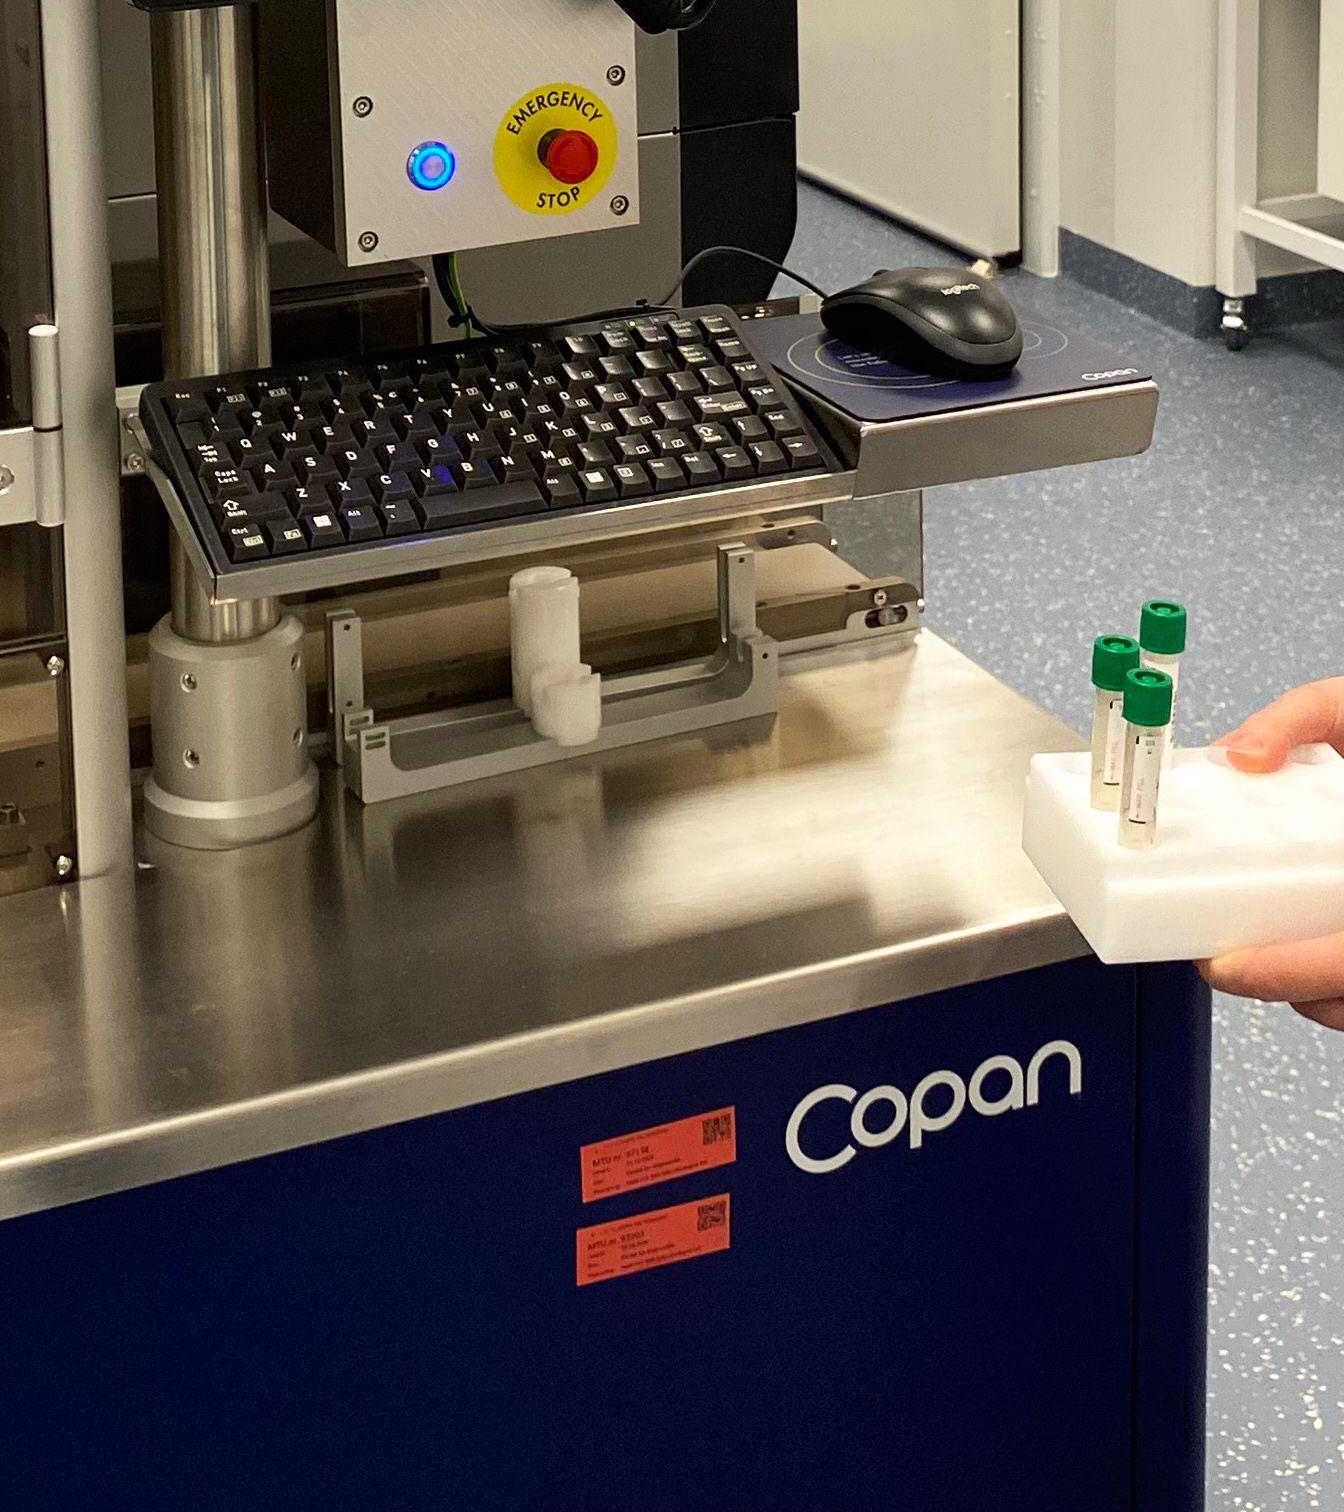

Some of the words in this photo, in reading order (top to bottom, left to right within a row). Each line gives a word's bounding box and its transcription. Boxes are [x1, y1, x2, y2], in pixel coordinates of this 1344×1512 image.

[506, 91, 604, 135] EMERGENCY
[536, 186, 581, 209] STOP
[1080, 368, 1139, 382] Copan
[240, 439, 253, 449] Q
[282, 431, 298, 443] W
[323, 426, 336, 436] E
[364, 420, 376, 430] R
[403, 414, 414, 424] T
[442, 408, 454, 418] Y
[482, 403, 495, 412] U
[559, 391, 571, 401] O
[598, 386, 607, 394] P
[264, 464, 277, 474] A
[304, 456, 318, 468] S
[345, 451, 358, 461] D
[386, 444, 397, 455] F
[427, 438, 440, 449] G
[466, 432, 480, 443] H
[509, 428, 517, 437] J
[544, 421, 559, 431] K
[584, 416, 597, 425] L
[214, 470, 237, 478] Caps
[217, 476, 240, 484] Lock
[227, 509, 248, 517] Shift
[296, 488, 309, 498] Z
[338, 482, 352, 492] X
[380, 475, 393, 485] C
[420, 468, 432, 478] V
[461, 462, 474, 472] B
[501, 456, 515, 466] N
[540, 450, 555, 460] M
[231, 527, 249, 536] Ctrl
[348, 510, 361, 518] Alt
[785, 1039, 1082, 1174] Copan
